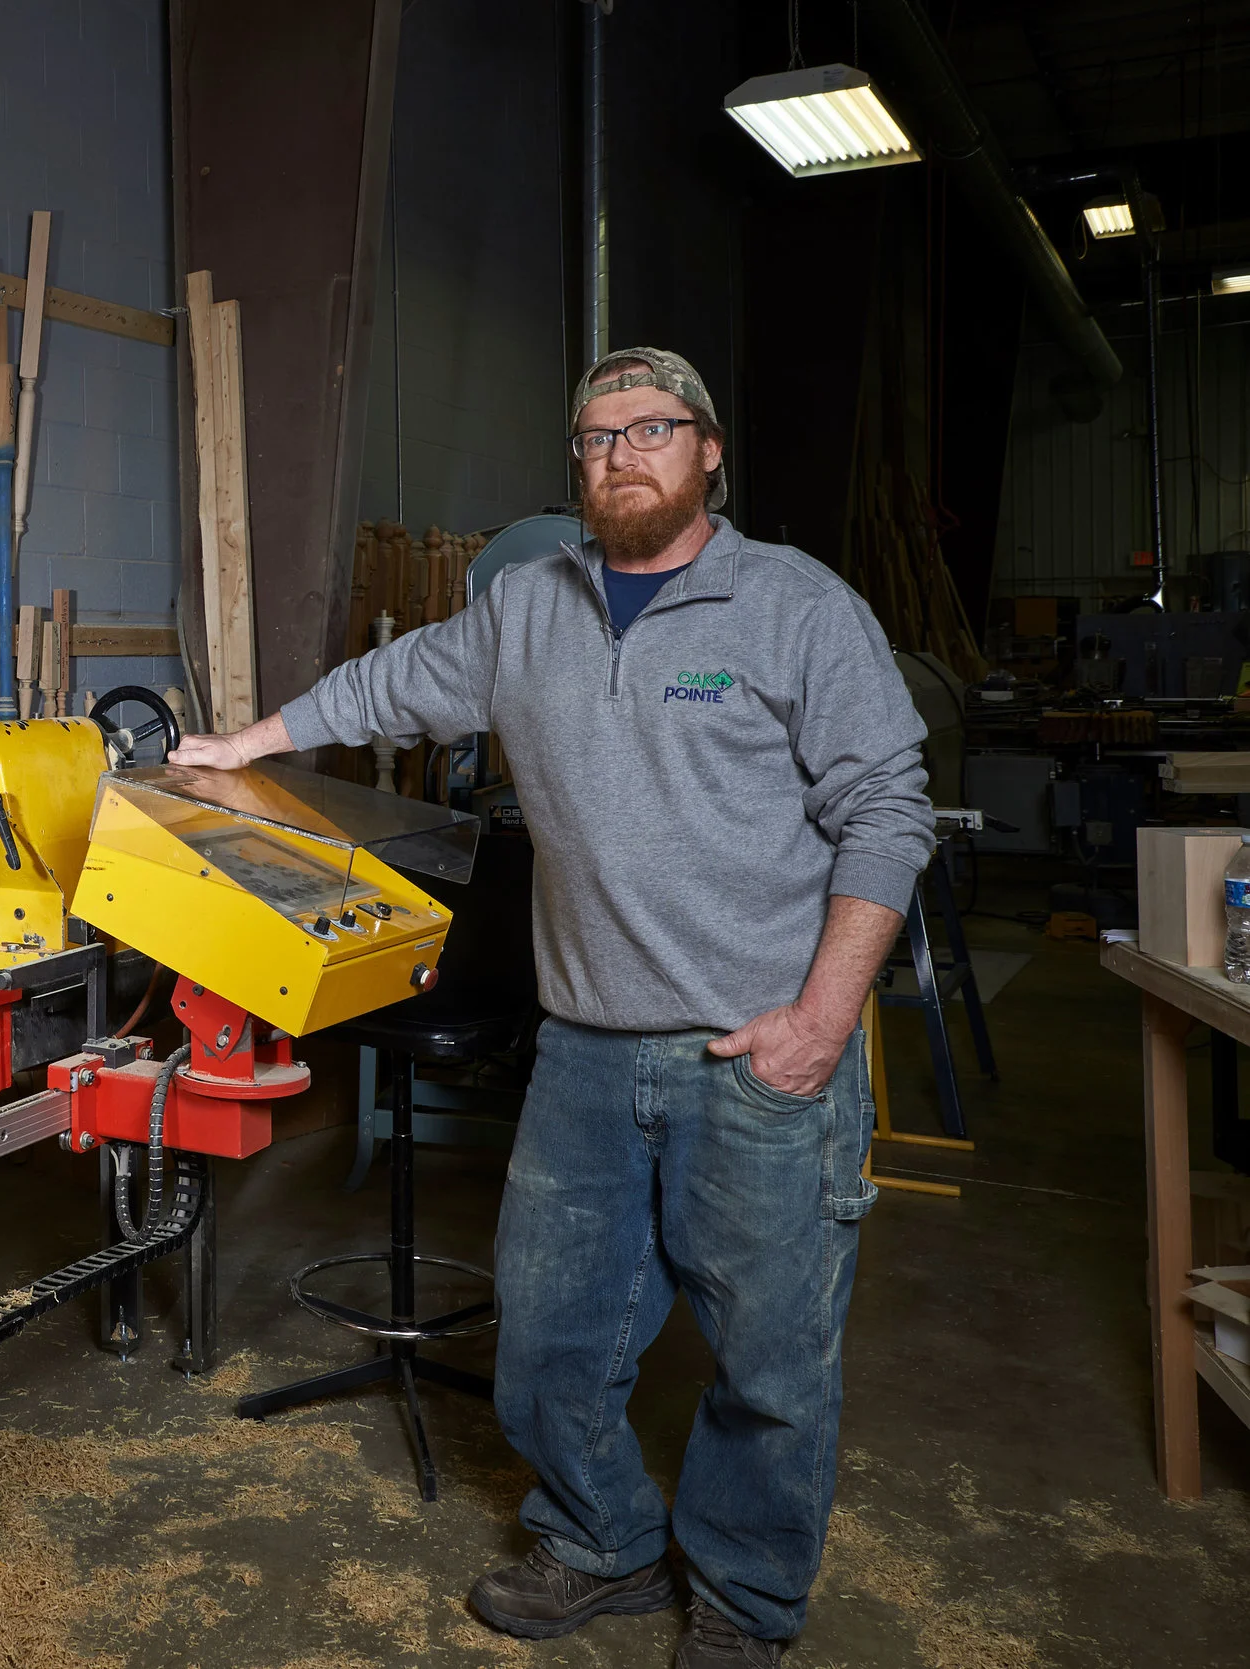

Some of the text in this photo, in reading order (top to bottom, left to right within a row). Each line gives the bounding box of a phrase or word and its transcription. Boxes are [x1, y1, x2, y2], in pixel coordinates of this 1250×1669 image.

[677, 671, 717, 689] OAK
[663, 686, 724, 704] POINTE
[502, 808, 520, 816] DE
